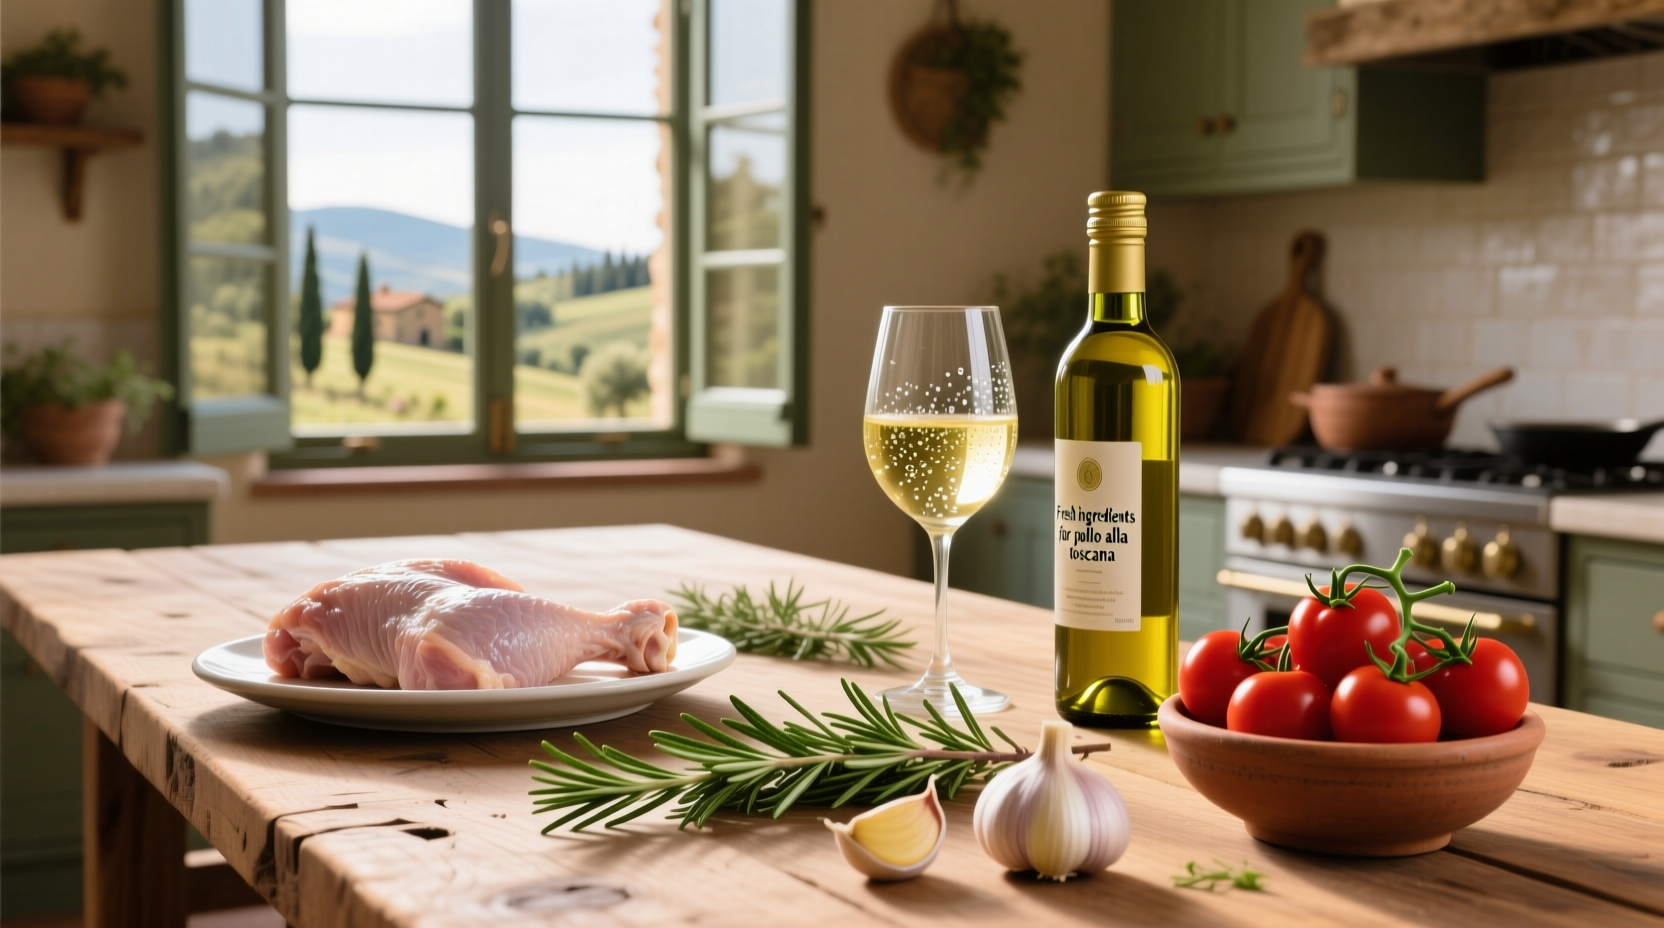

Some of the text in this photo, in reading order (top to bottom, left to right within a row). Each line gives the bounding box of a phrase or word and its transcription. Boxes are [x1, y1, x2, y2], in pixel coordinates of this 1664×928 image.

[1074, 527, 1102, 546] pollo
[1105, 527, 1128, 544] alla
[1069, 547, 1116, 562] toscana
